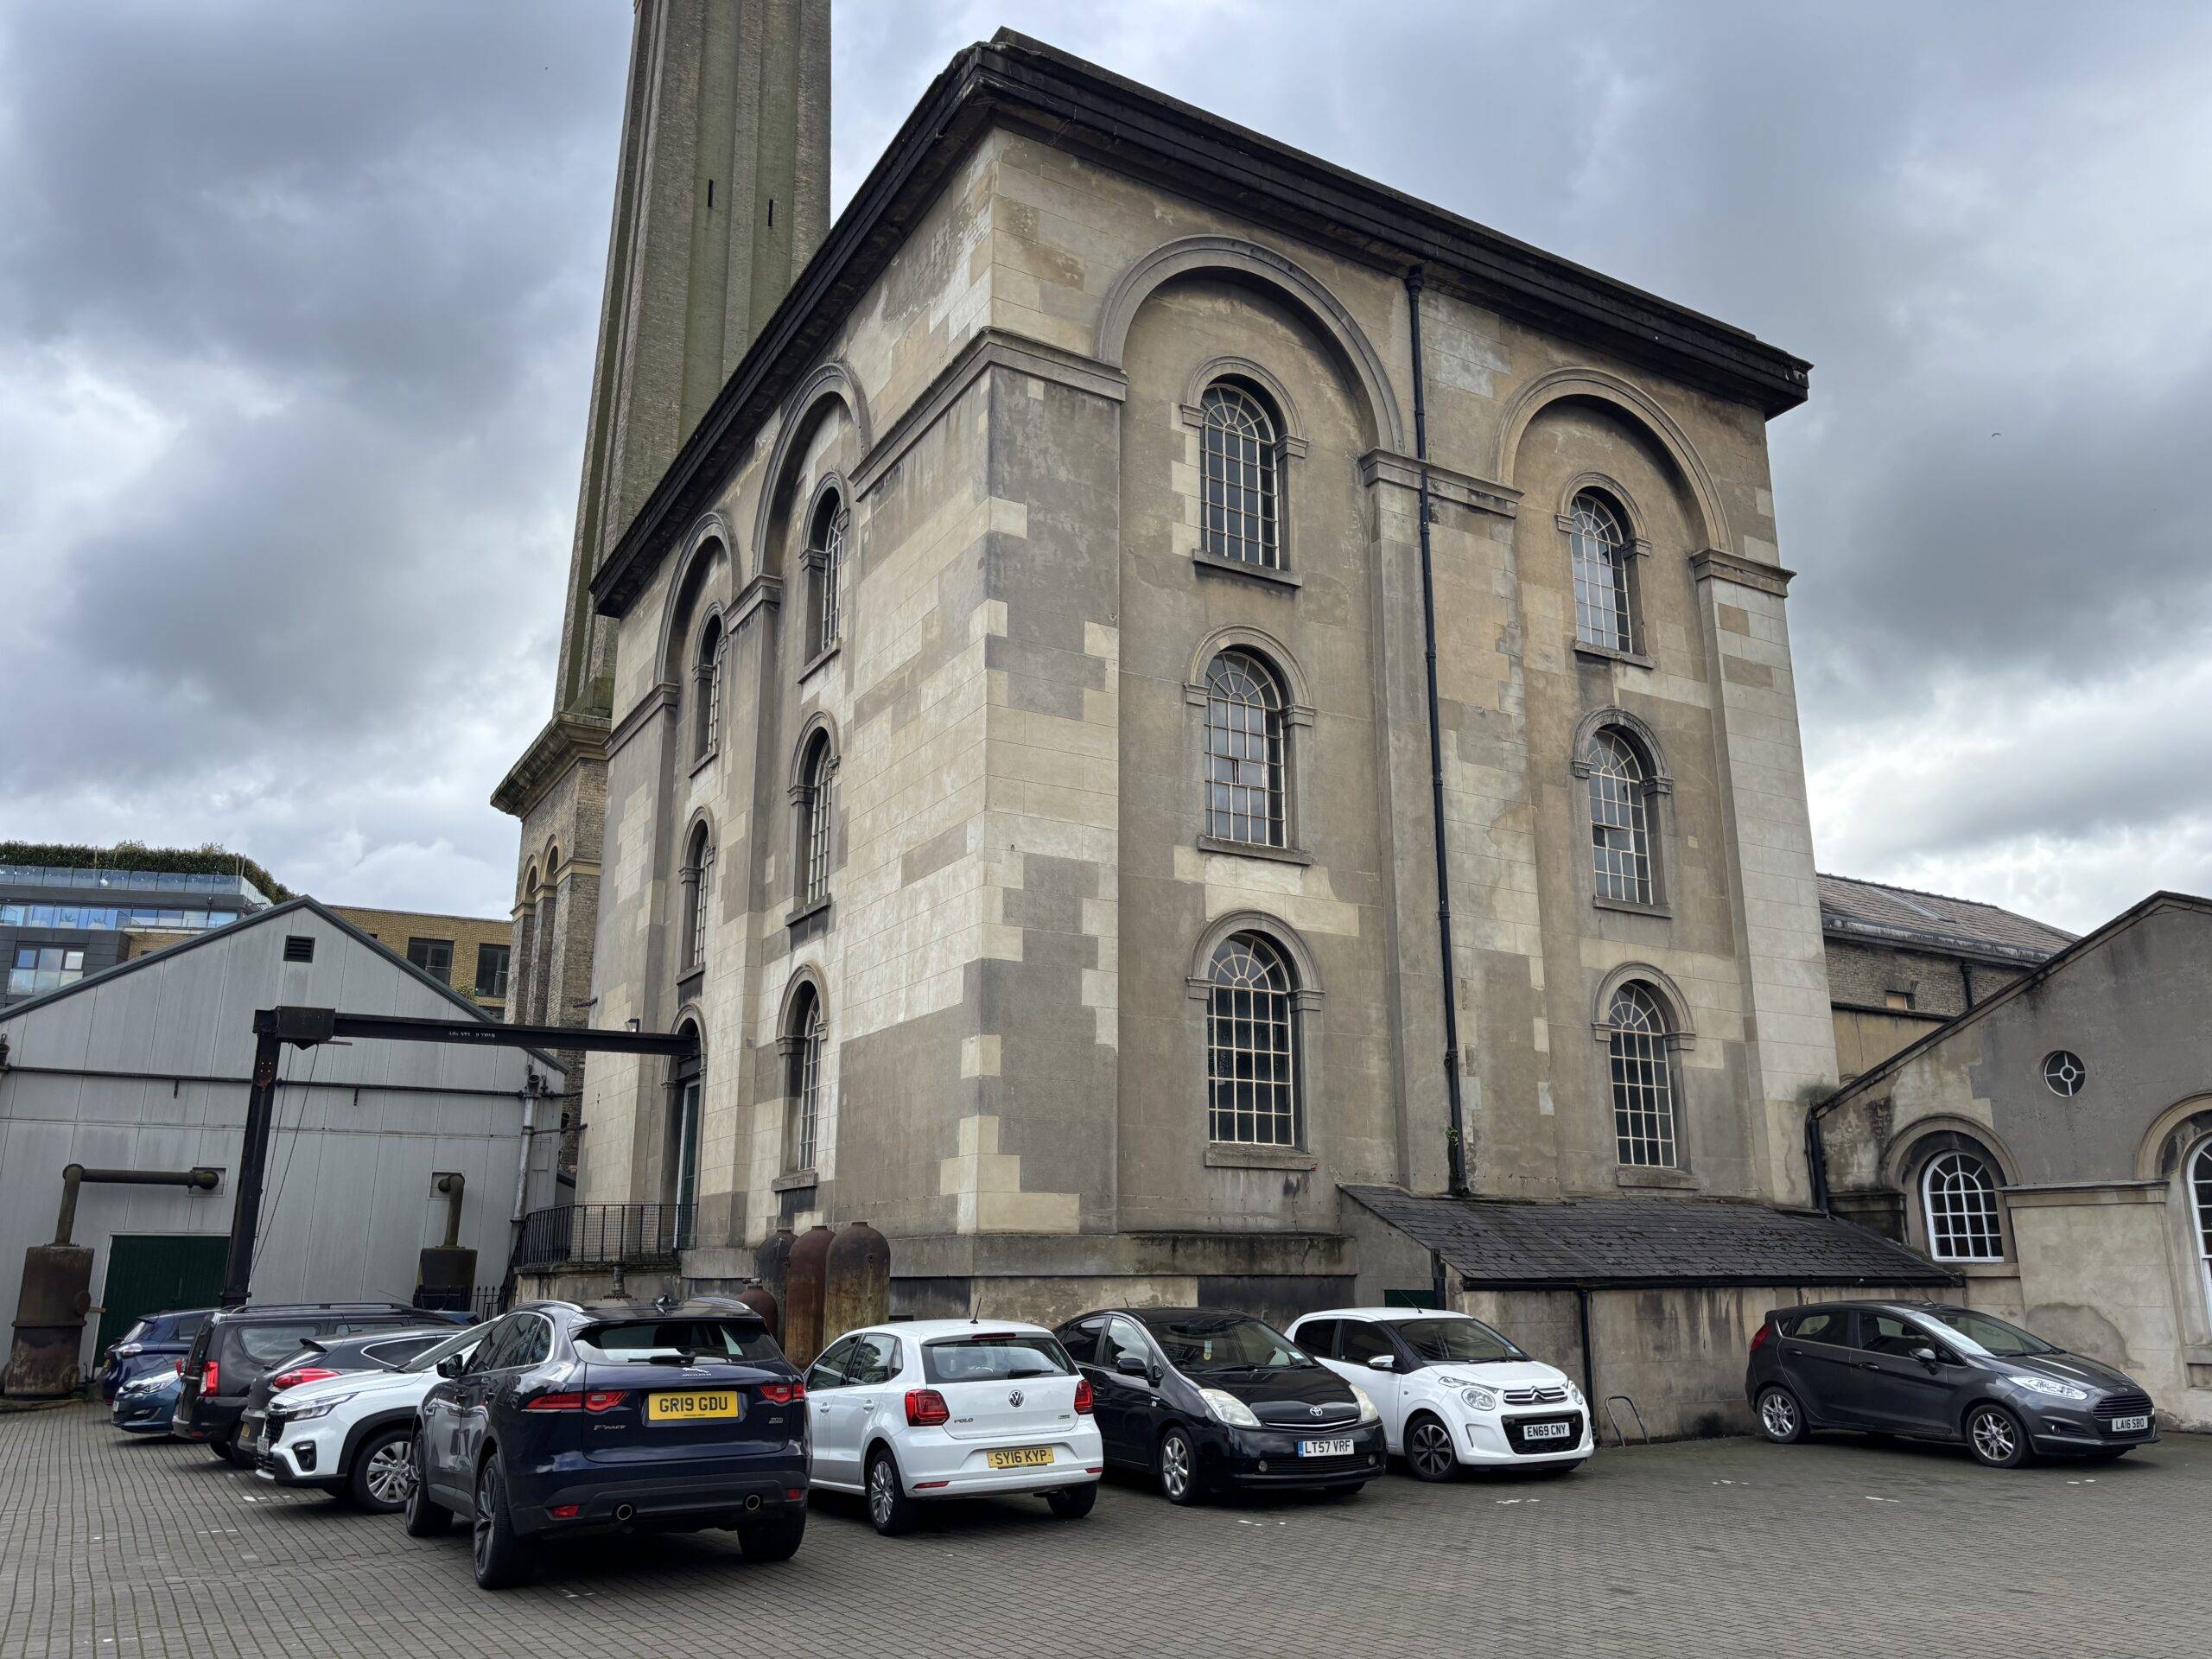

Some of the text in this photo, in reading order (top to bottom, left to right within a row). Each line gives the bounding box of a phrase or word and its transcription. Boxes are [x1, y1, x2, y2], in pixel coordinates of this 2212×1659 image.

[659, 1395, 728, 1413] GR19 GDU
[1527, 1424, 1566, 1438] EN69 CNY
[2116, 1419, 2131, 1430] LA16
[1305, 1440, 1351, 1453] LT57 VRF
[995, 1449, 1046, 1465] SY16 KYP
